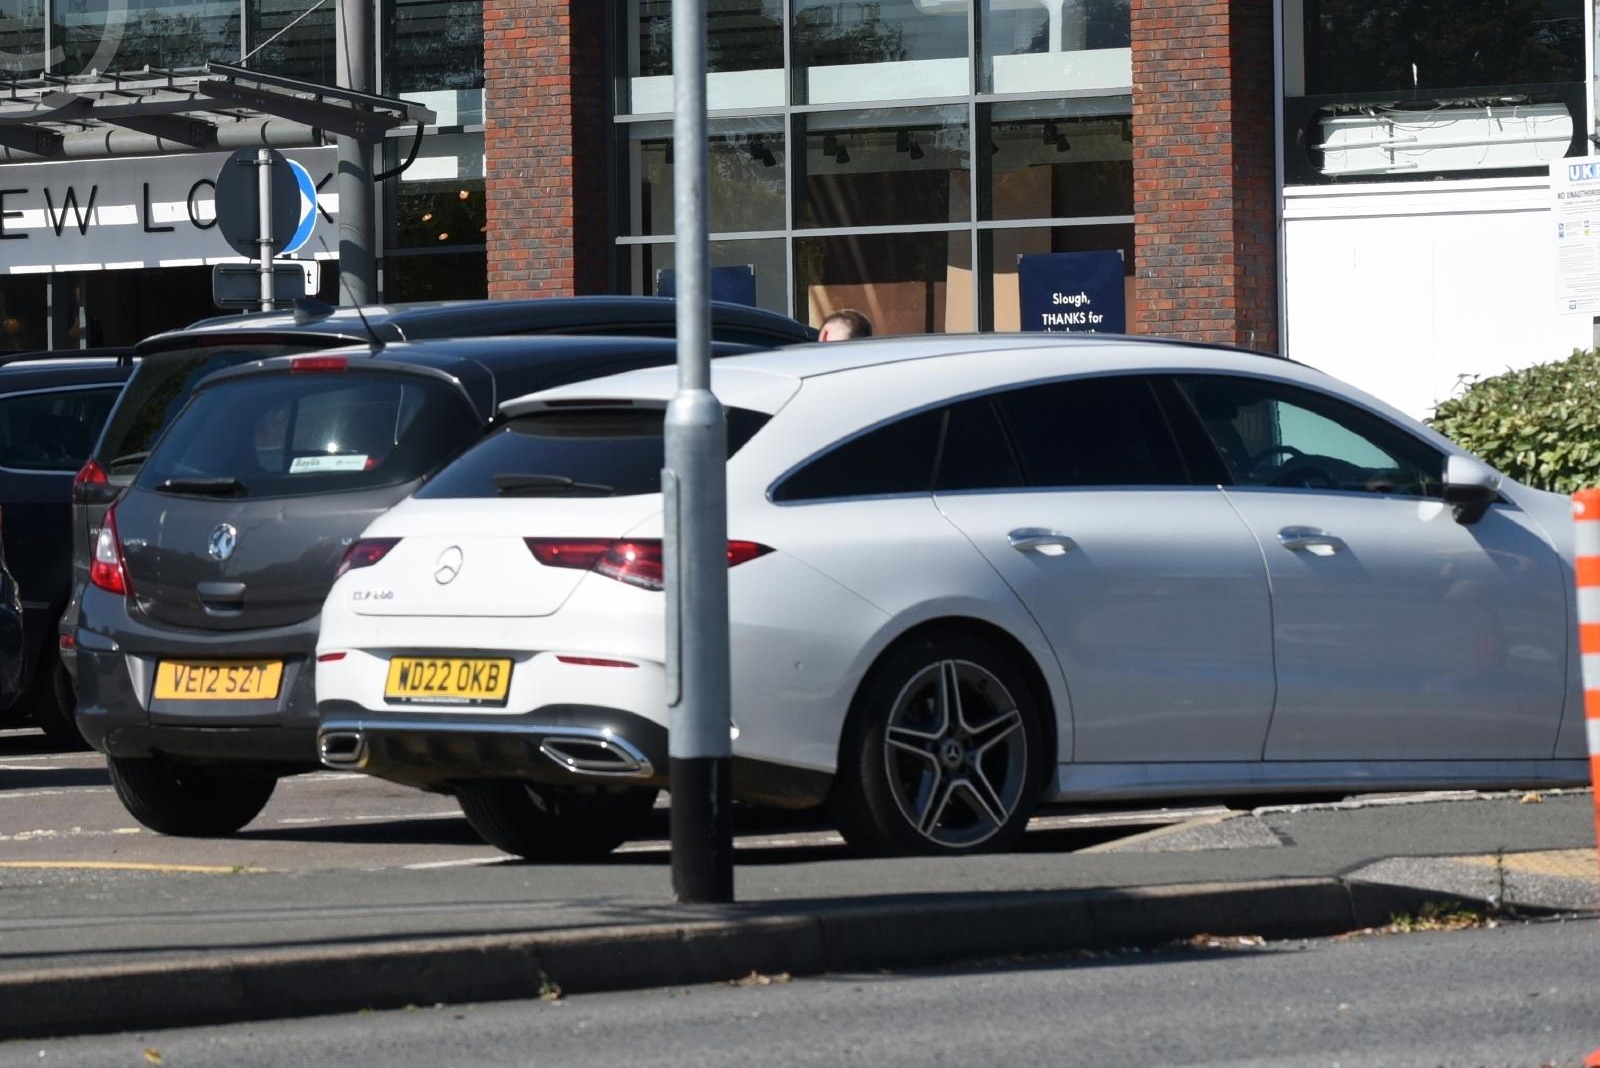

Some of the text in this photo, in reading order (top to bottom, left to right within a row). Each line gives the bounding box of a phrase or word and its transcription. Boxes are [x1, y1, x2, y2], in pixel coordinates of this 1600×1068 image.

[1569, 164, 1600, 181] UK
[1053, 292, 1090, 307] Slough,
[1042, 311, 1103, 325] THANKS for
[174, 665, 266, 692] VE12 SZT
[398, 662, 500, 692] WD22 OKB
